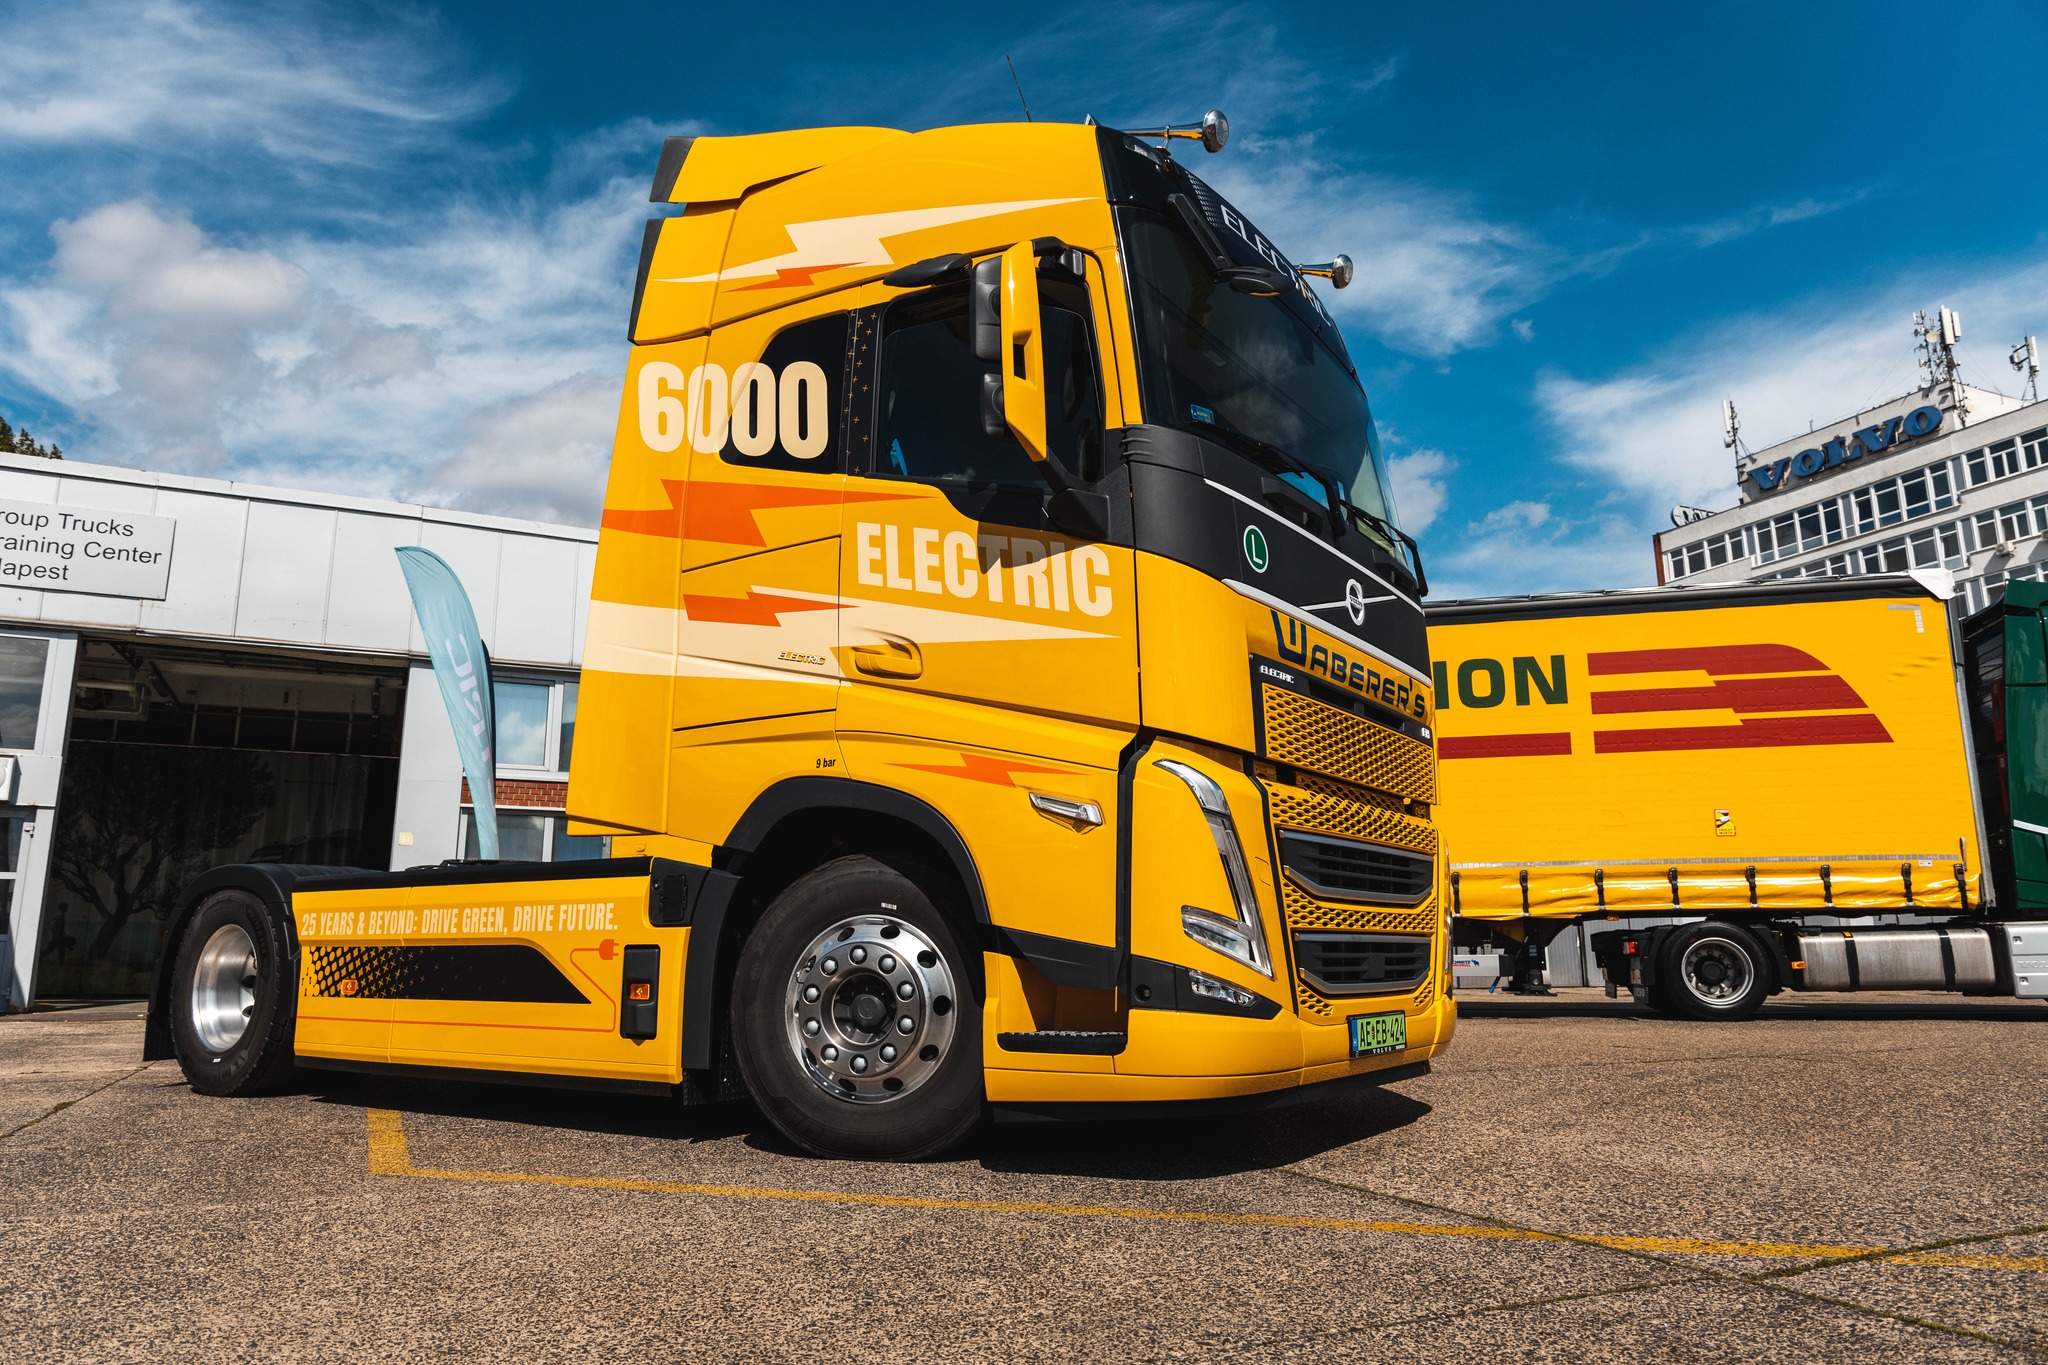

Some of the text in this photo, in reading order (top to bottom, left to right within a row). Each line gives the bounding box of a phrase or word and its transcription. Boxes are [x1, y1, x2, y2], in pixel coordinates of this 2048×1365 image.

[1220, 204, 1332, 327] ELECTRIC
[638, 361, 829, 459] 6000
[1746, 405, 1943, 490] VOLVO
[58, 512, 134, 537] Trucks
[84, 541, 162, 564] Center
[857, 521, 1113, 617] ELECTRIC
[777, 651, 826, 666] ELECTRIC
[1260, 665, 1295, 684] ELECTRIC
[1270, 609, 1426, 718] WABERER'S
[1432, 654, 1569, 710] ION
[815, 757, 836, 769] 9 bar
[301, 902, 619, 936] 25 YEARS & BEYOND: DRIVE GREEN, DRIVE FUTURE.
[1372, 1046, 1391, 1054] VOLVO
